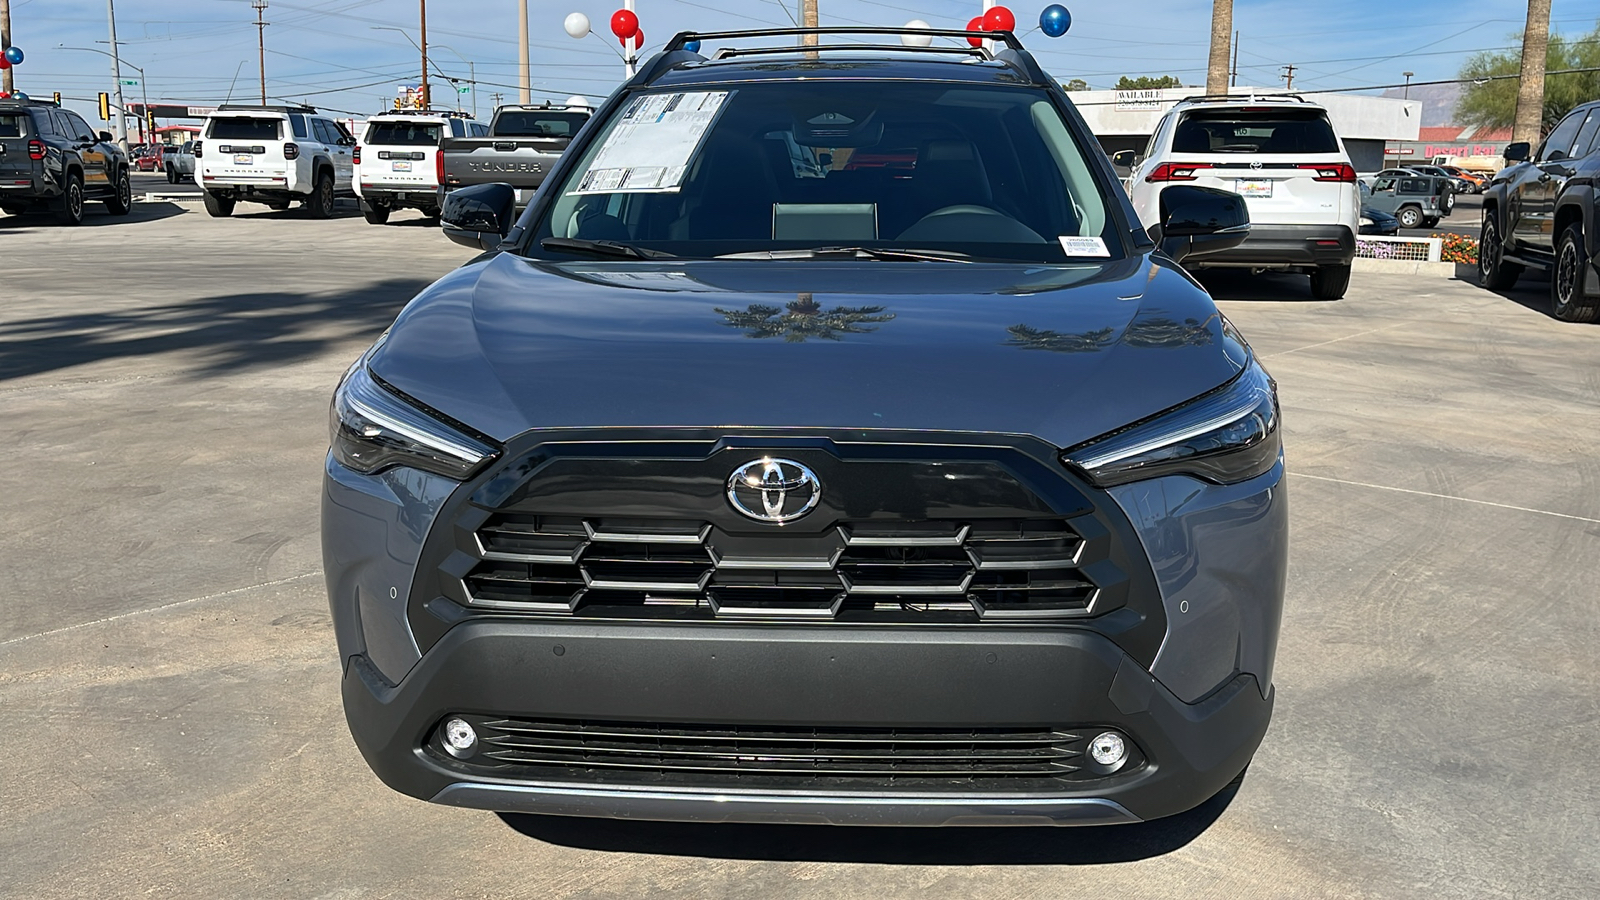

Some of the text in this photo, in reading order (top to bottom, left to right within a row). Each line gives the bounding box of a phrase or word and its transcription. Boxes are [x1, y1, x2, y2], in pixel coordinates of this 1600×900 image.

[1117, 91, 1162, 99] AVAILABLE
[1424, 144, 1496, 158] Desert Rat
[468, 161, 542, 173] TUNDRA
